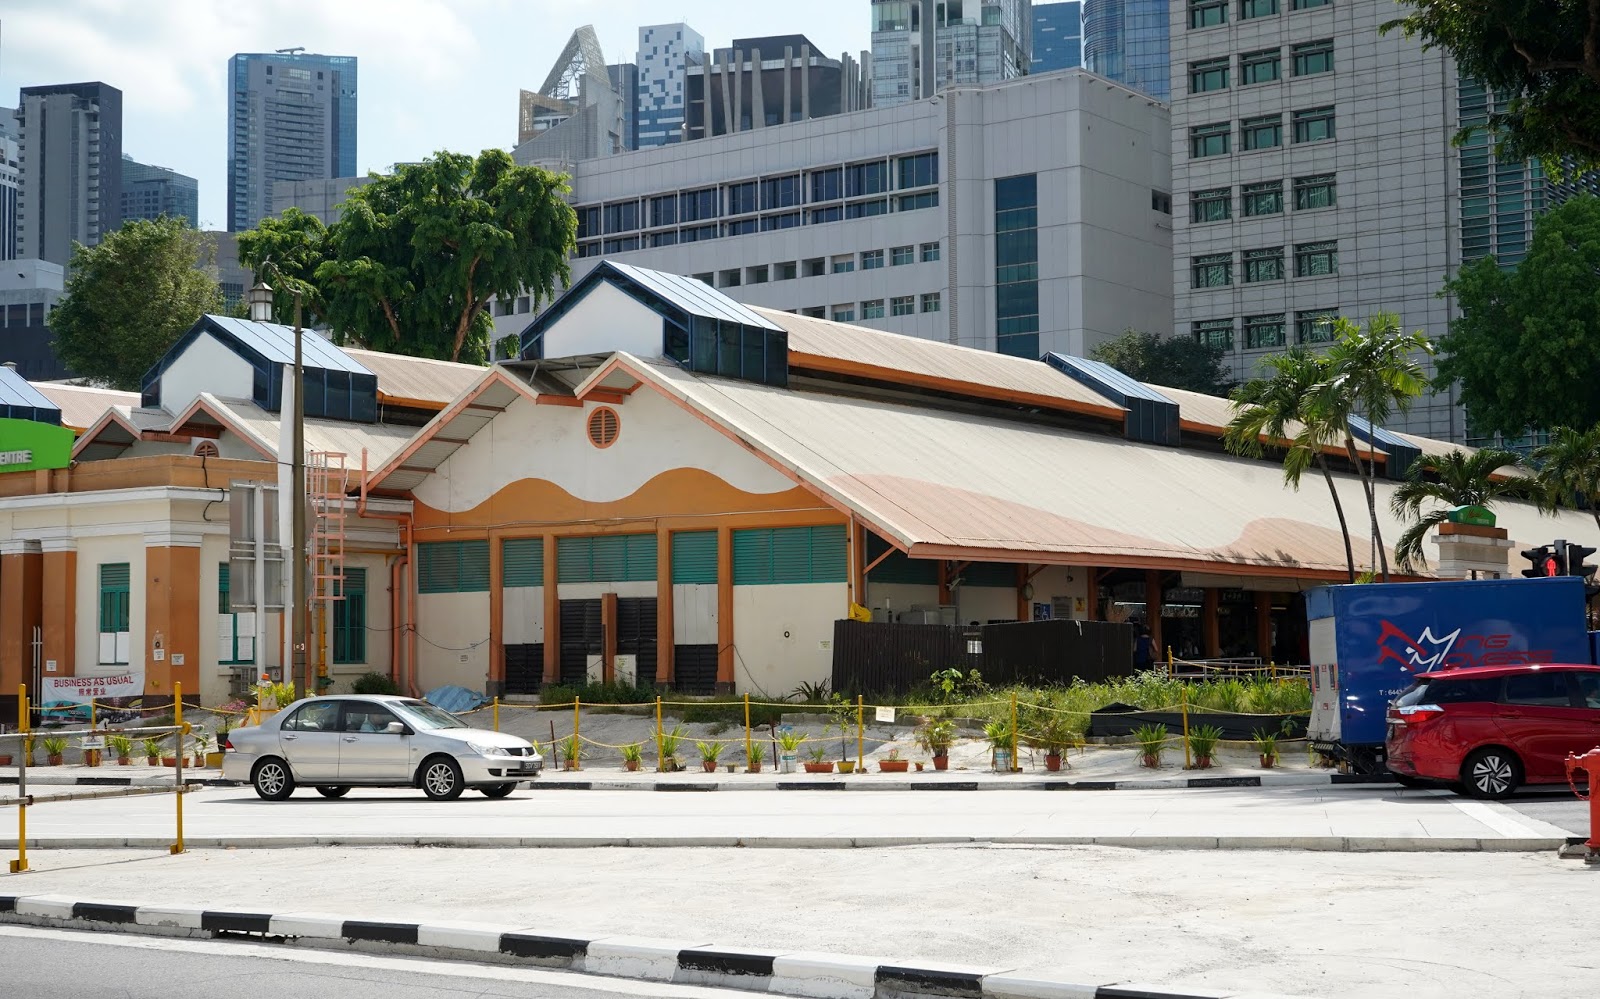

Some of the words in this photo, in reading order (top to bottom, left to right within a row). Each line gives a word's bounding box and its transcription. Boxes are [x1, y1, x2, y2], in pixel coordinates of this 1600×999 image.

[54, 678, 92, 688] BUSINESS
[93, 677, 105, 686] AS
[106, 675, 134, 686] USUAL
